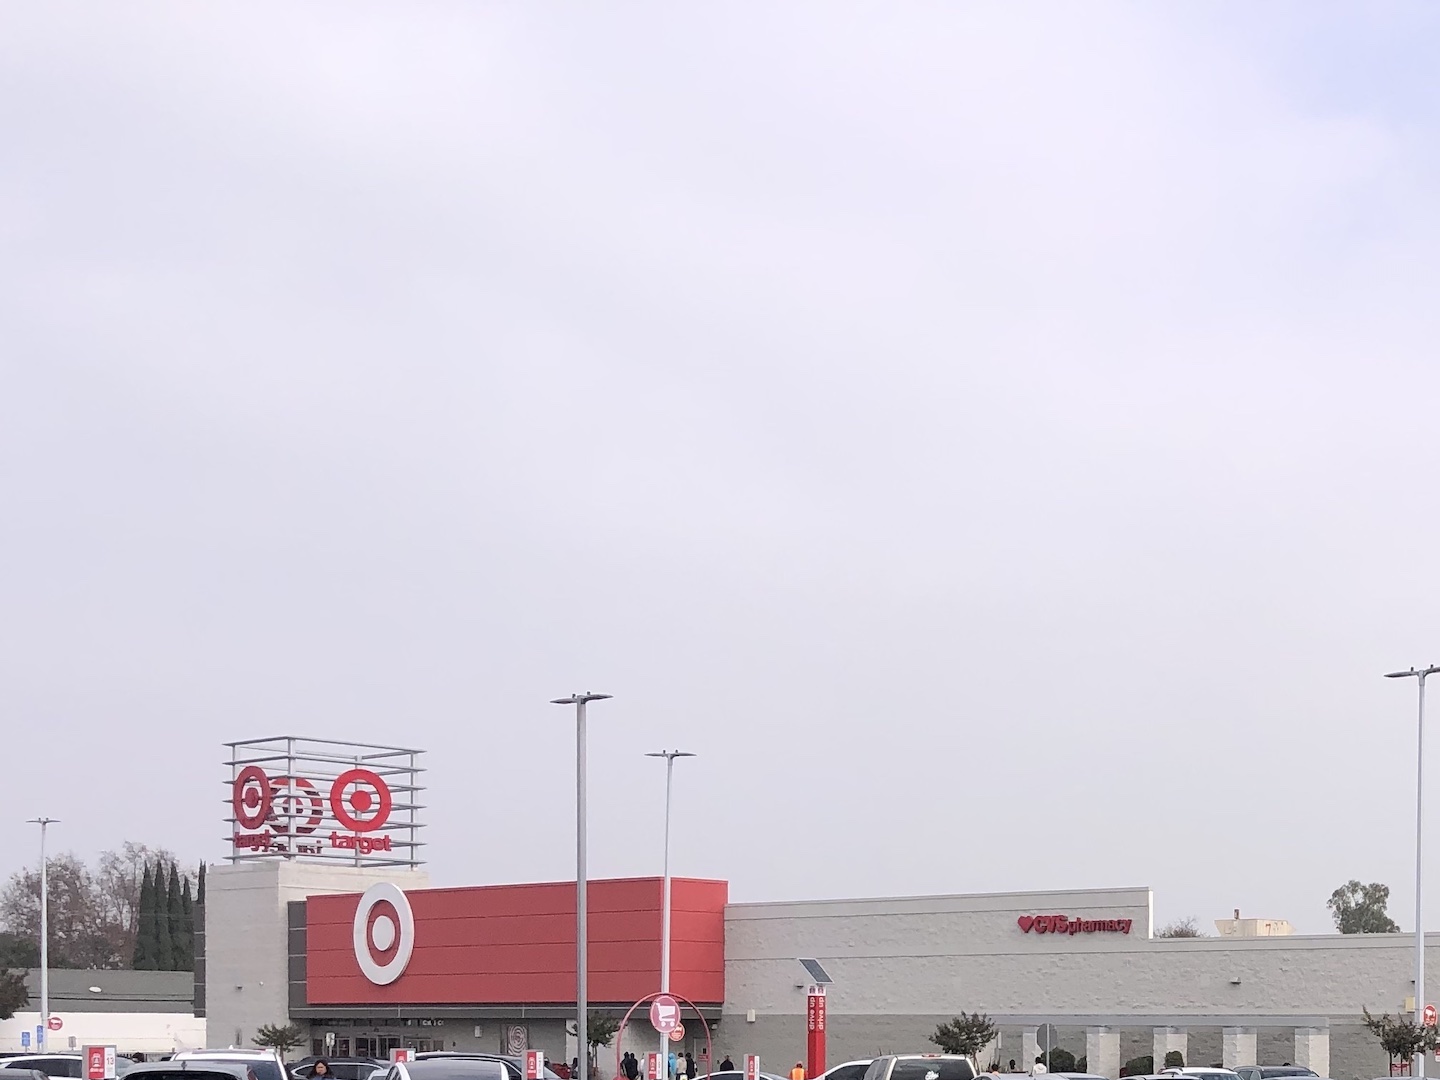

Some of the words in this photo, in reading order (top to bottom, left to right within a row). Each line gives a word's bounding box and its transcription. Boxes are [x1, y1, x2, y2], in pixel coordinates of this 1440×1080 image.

[329, 831, 392, 854] target
[1033, 915, 1068, 934] CVS
[1068, 917, 1132, 935] pharmacy
[809, 996, 816, 1008] up
[818, 996, 825, 1008] up
